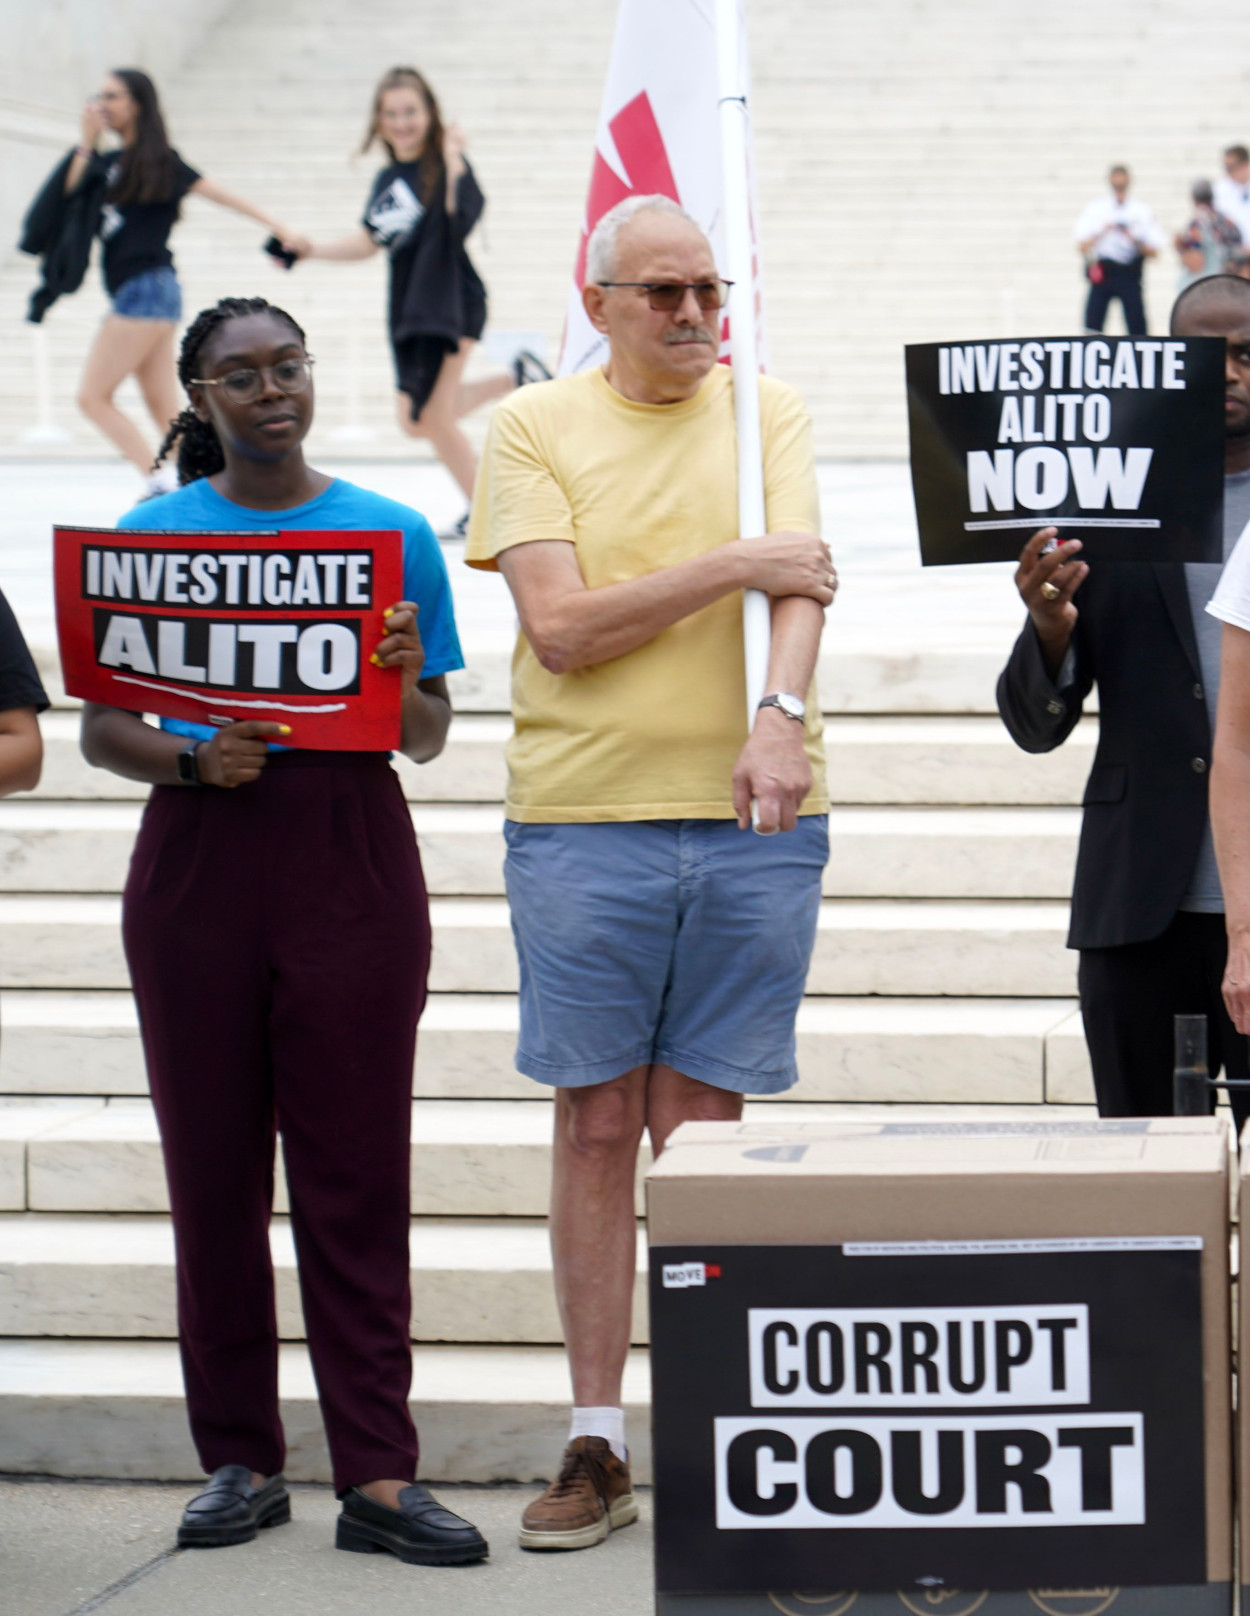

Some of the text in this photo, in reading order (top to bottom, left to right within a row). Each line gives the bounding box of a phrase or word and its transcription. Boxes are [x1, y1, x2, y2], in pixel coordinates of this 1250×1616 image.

[938, 341, 1186, 395] INVESTIGATE
[998, 393, 1111, 445] ALITO
[967, 446, 1153, 513] NOW
[86, 549, 371, 606] INVESTIGATE
[98, 615, 358, 692] ALITO
[762, 1318, 1078, 1396] CORRUPT
[726, 1425, 1135, 1517] COURT
